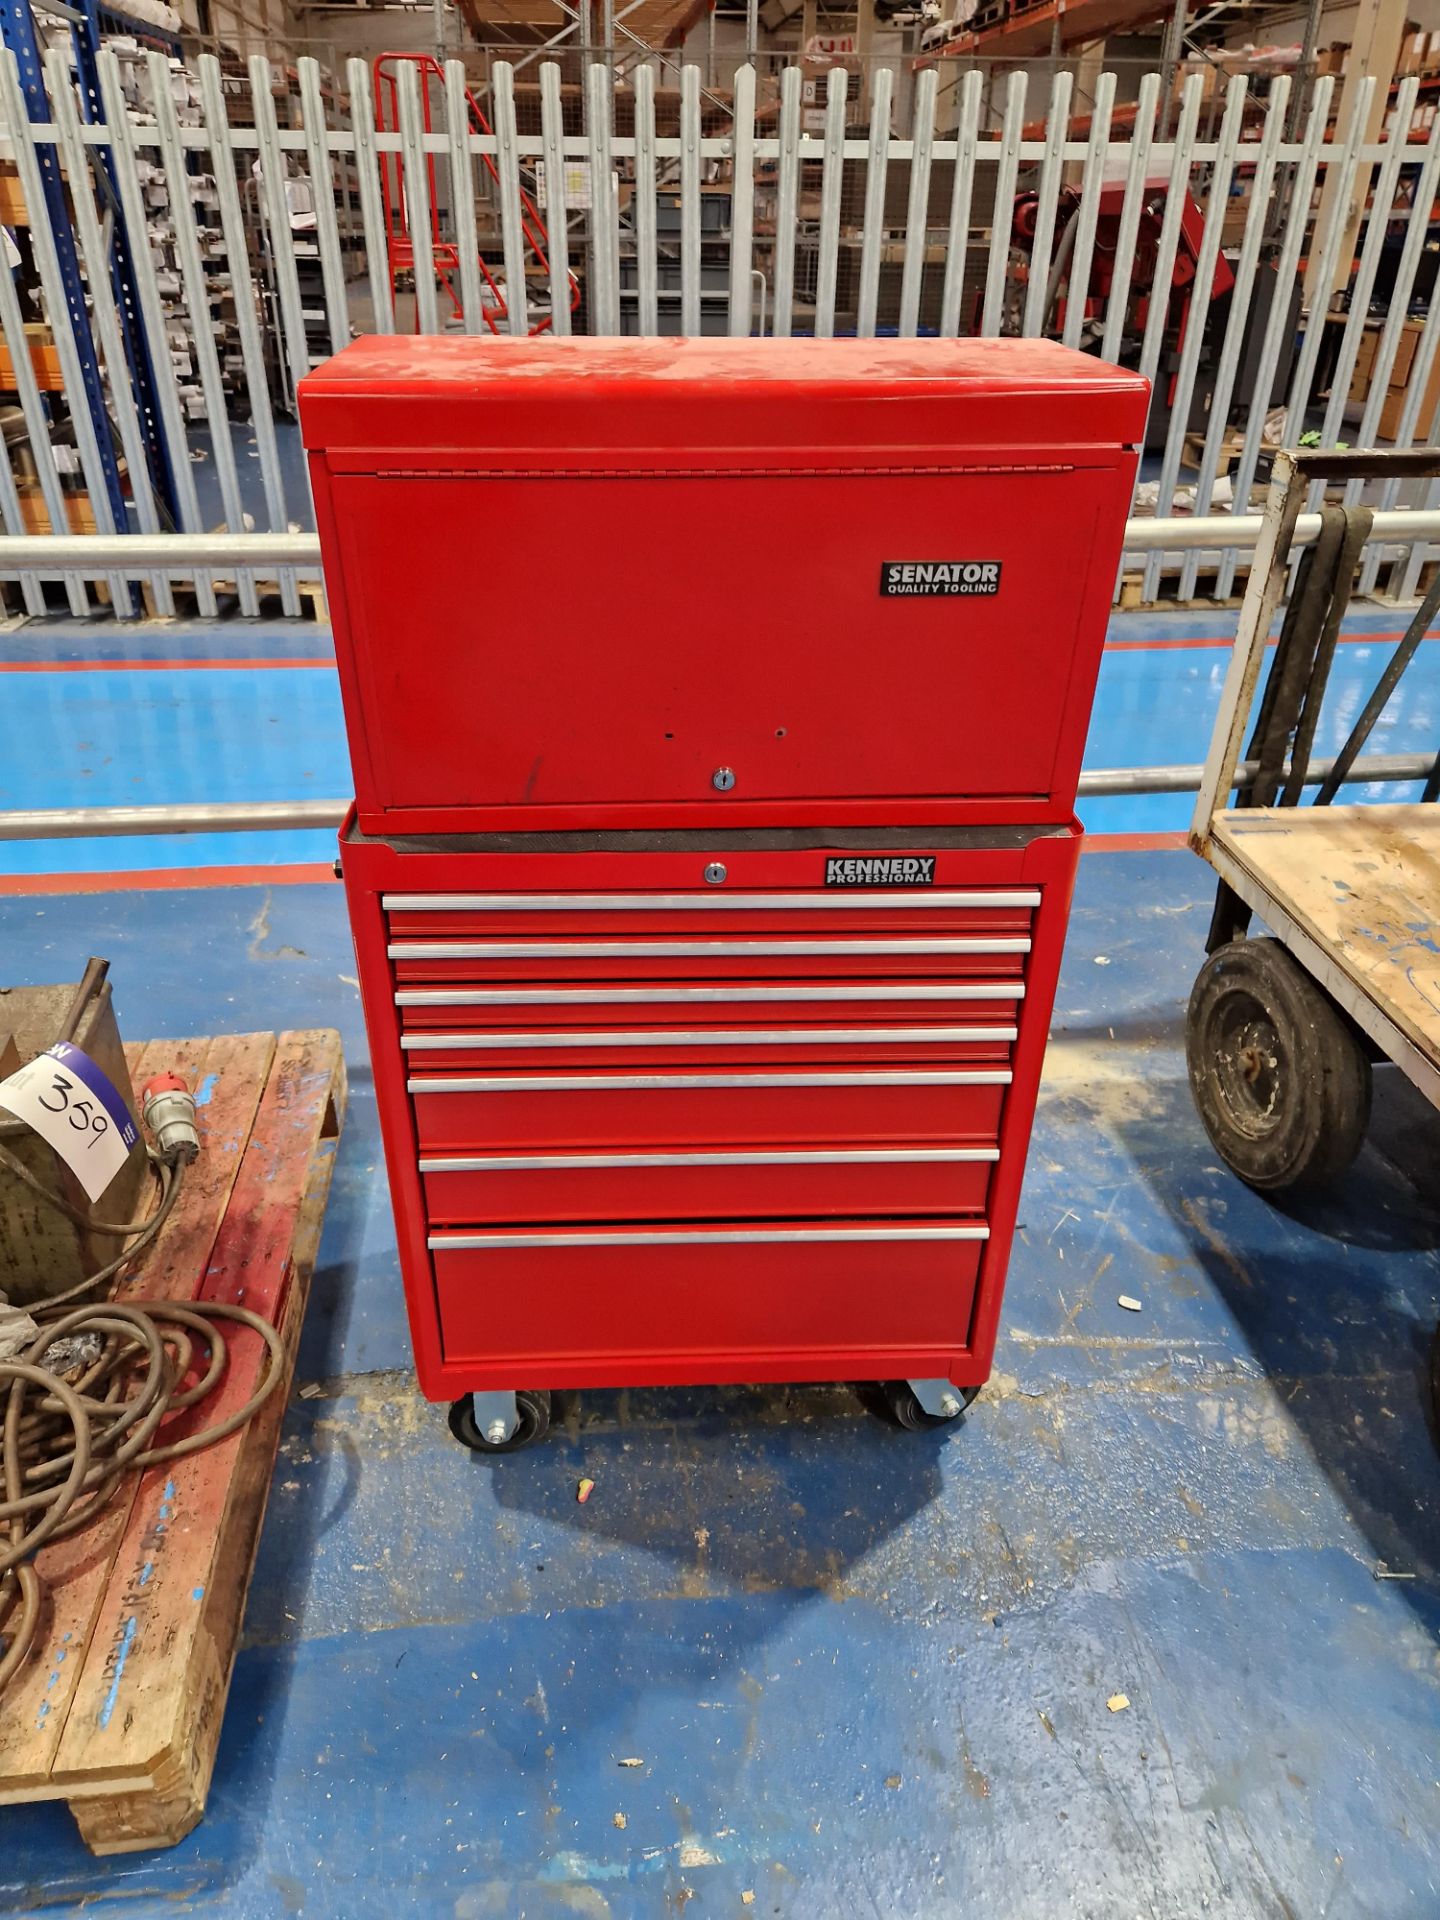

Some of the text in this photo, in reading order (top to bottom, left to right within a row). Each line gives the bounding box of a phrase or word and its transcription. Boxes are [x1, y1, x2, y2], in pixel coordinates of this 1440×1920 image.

[888, 564, 998, 583] SENATOR
[888, 583, 997, 594] QUALITY TOOLING
[827, 858, 935, 875] KENNEDY
[826, 873, 932, 884] PROFESSIONAL
[38, 1073, 109, 1150] 359
